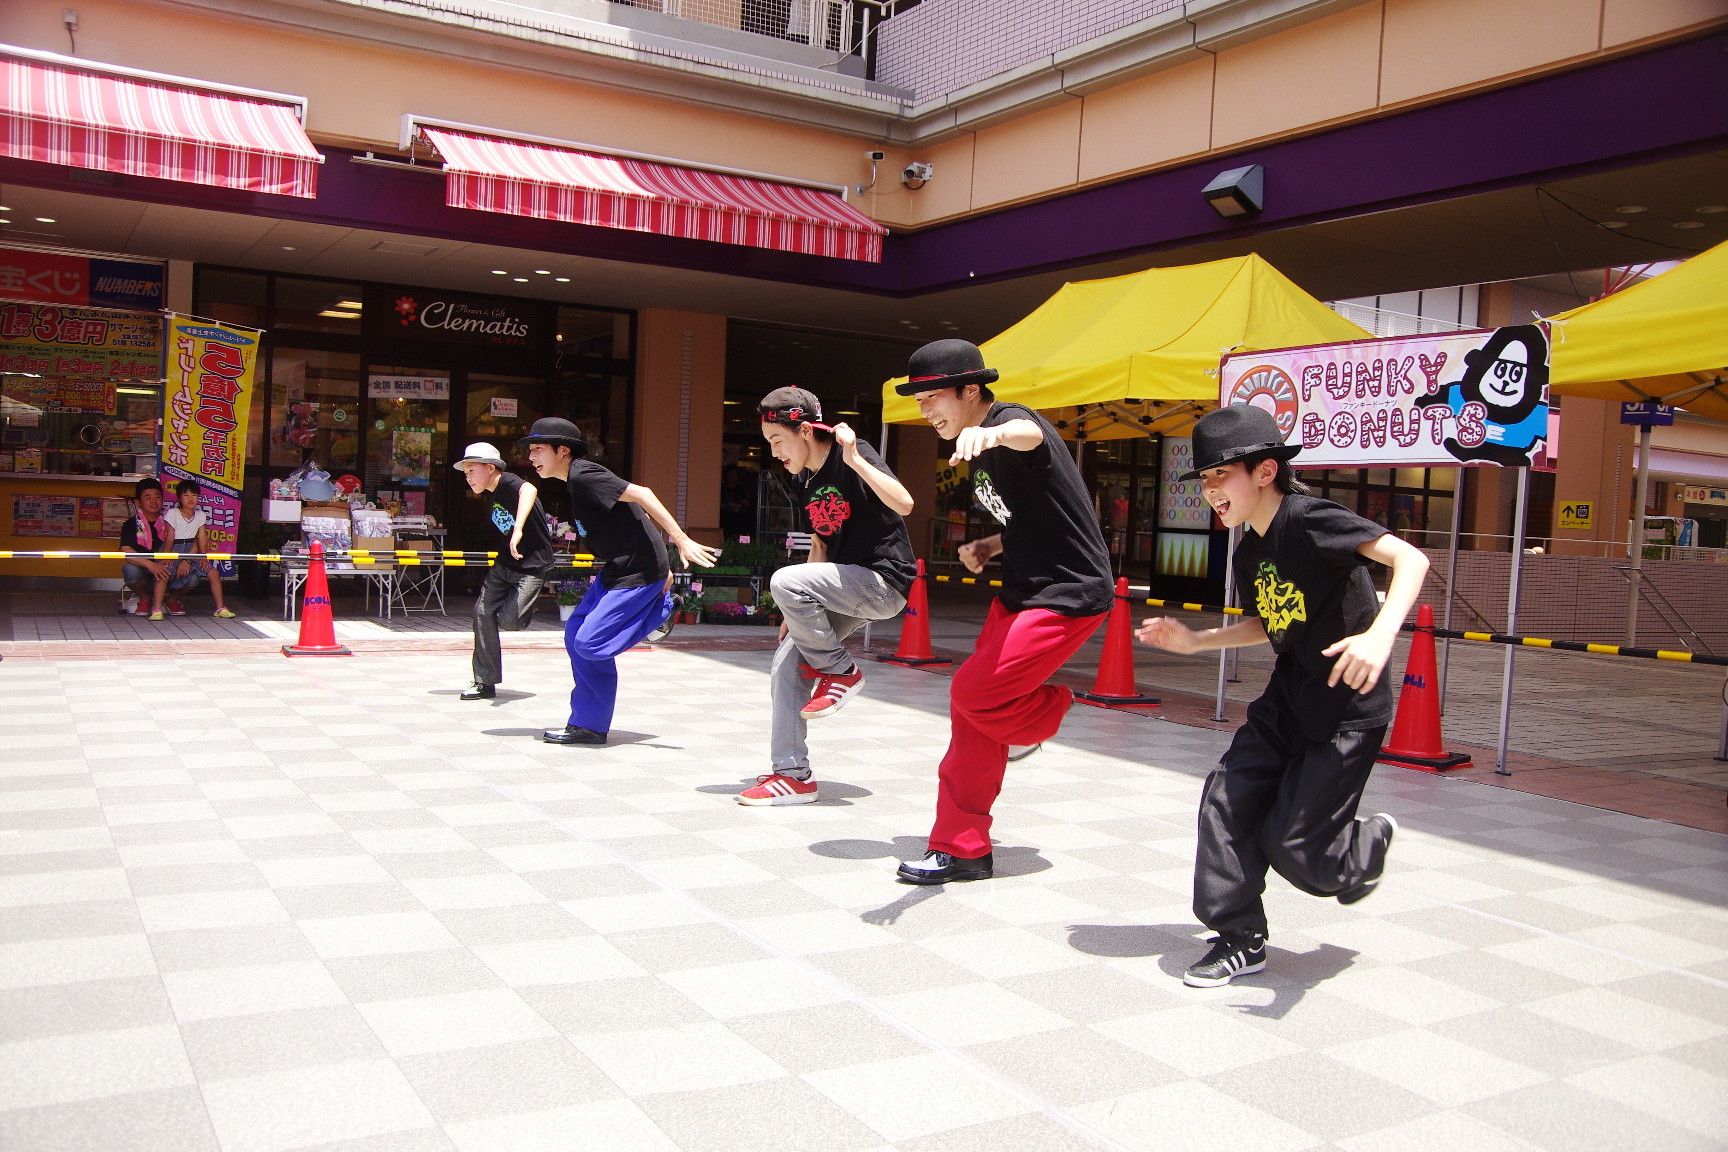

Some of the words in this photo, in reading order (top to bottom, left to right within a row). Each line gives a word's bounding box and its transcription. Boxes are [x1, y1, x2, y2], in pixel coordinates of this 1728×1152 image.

[94, 276, 162, 298] NUMBERS
[420, 300, 529, 338] Clematis
[1301, 352, 1448, 403] FUNKY
[1302, 402, 1488, 450] DONUTS
